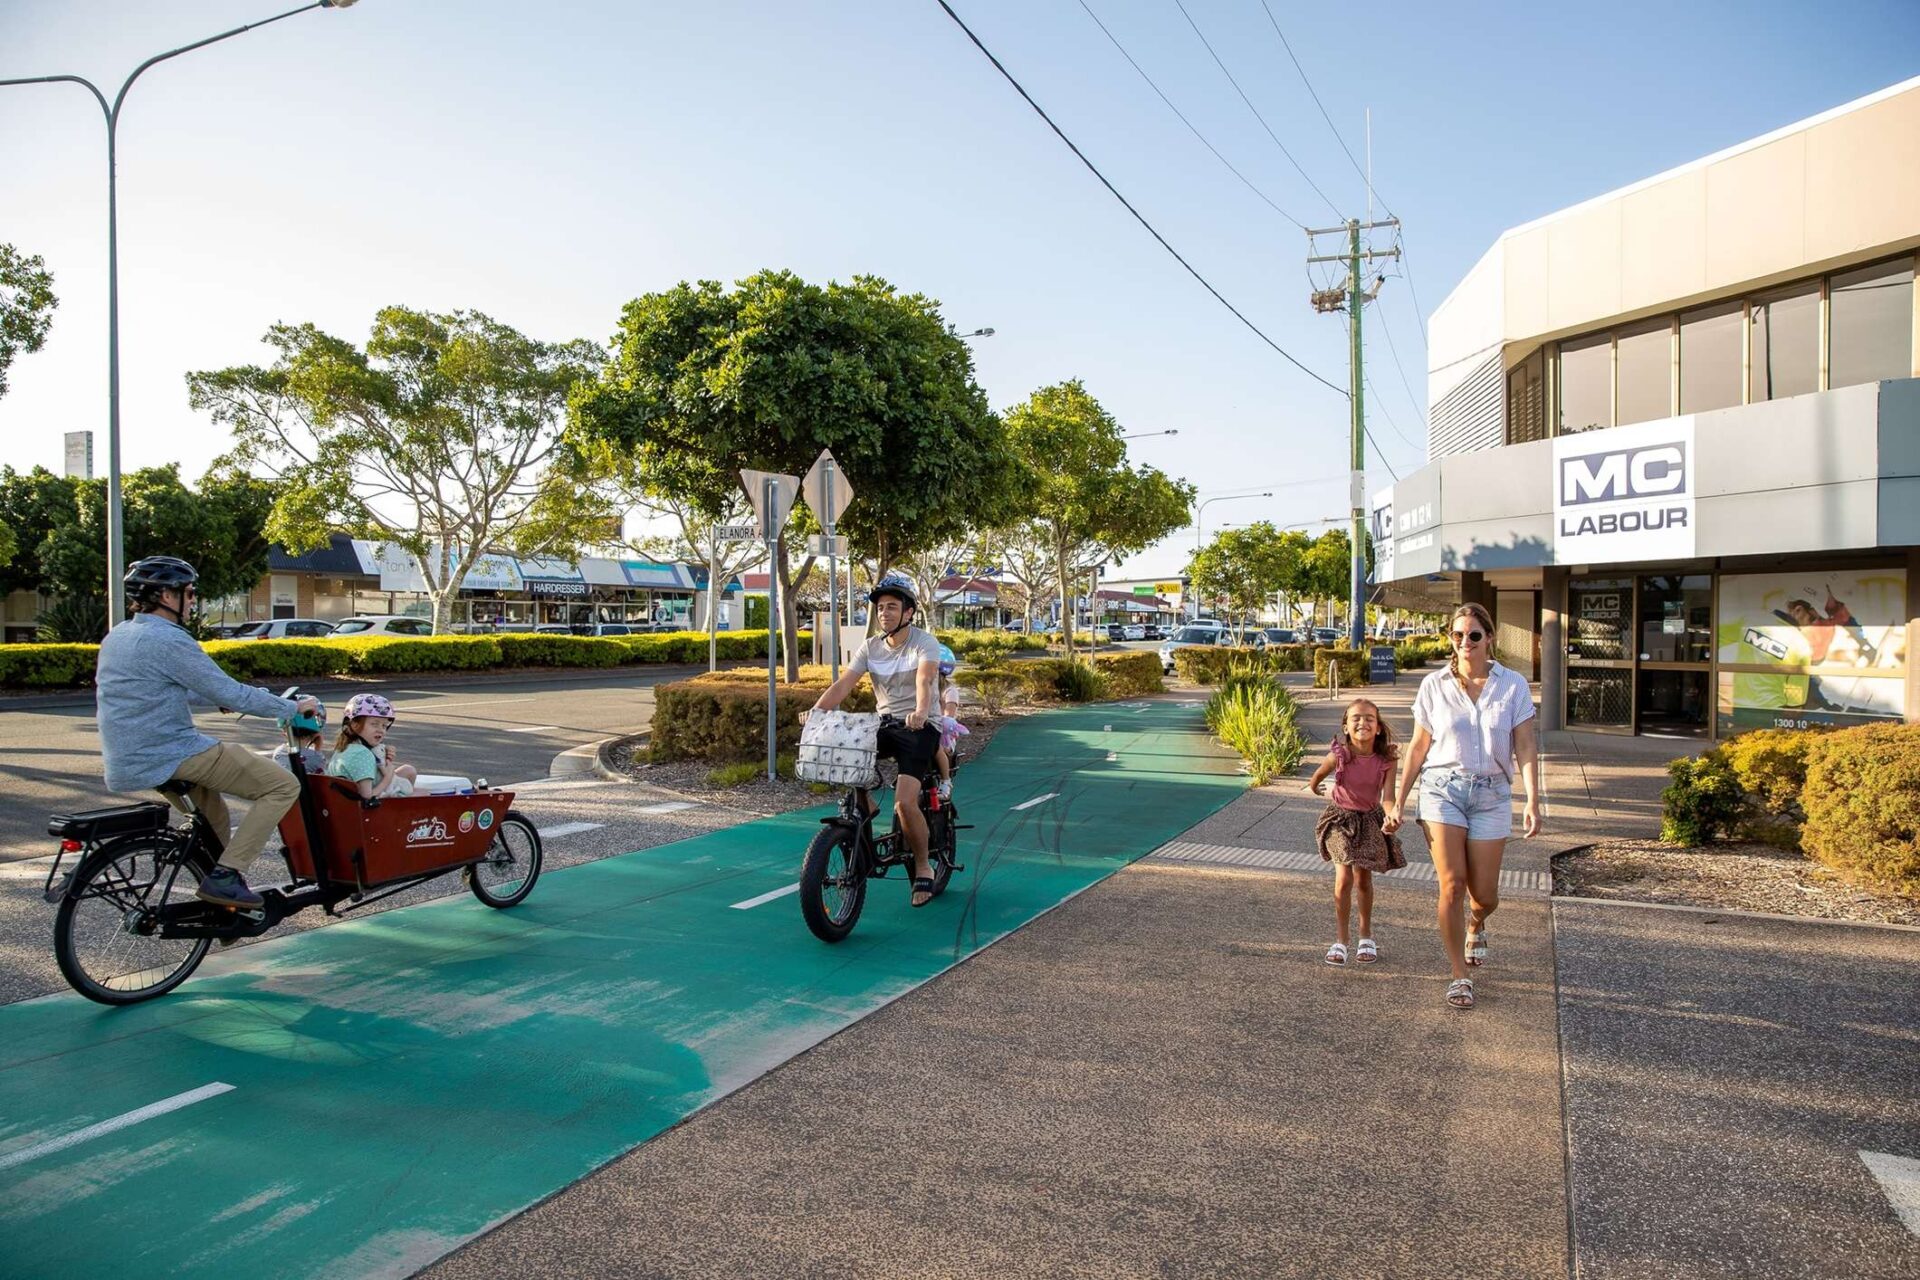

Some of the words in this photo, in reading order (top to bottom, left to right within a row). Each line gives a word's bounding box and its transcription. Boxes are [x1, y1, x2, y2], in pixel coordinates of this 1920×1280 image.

[1562, 445, 1684, 503] MC
[1560, 507, 1688, 537] LABOUR
[720, 528, 755, 539] ELANORA
[533, 582, 585, 594] HAIRDRESSER
[1582, 595, 1619, 610] MC
[1744, 629, 1788, 660] MC
[1774, 719, 1795, 728] 1300
[1797, 720, 1807, 729] 10
